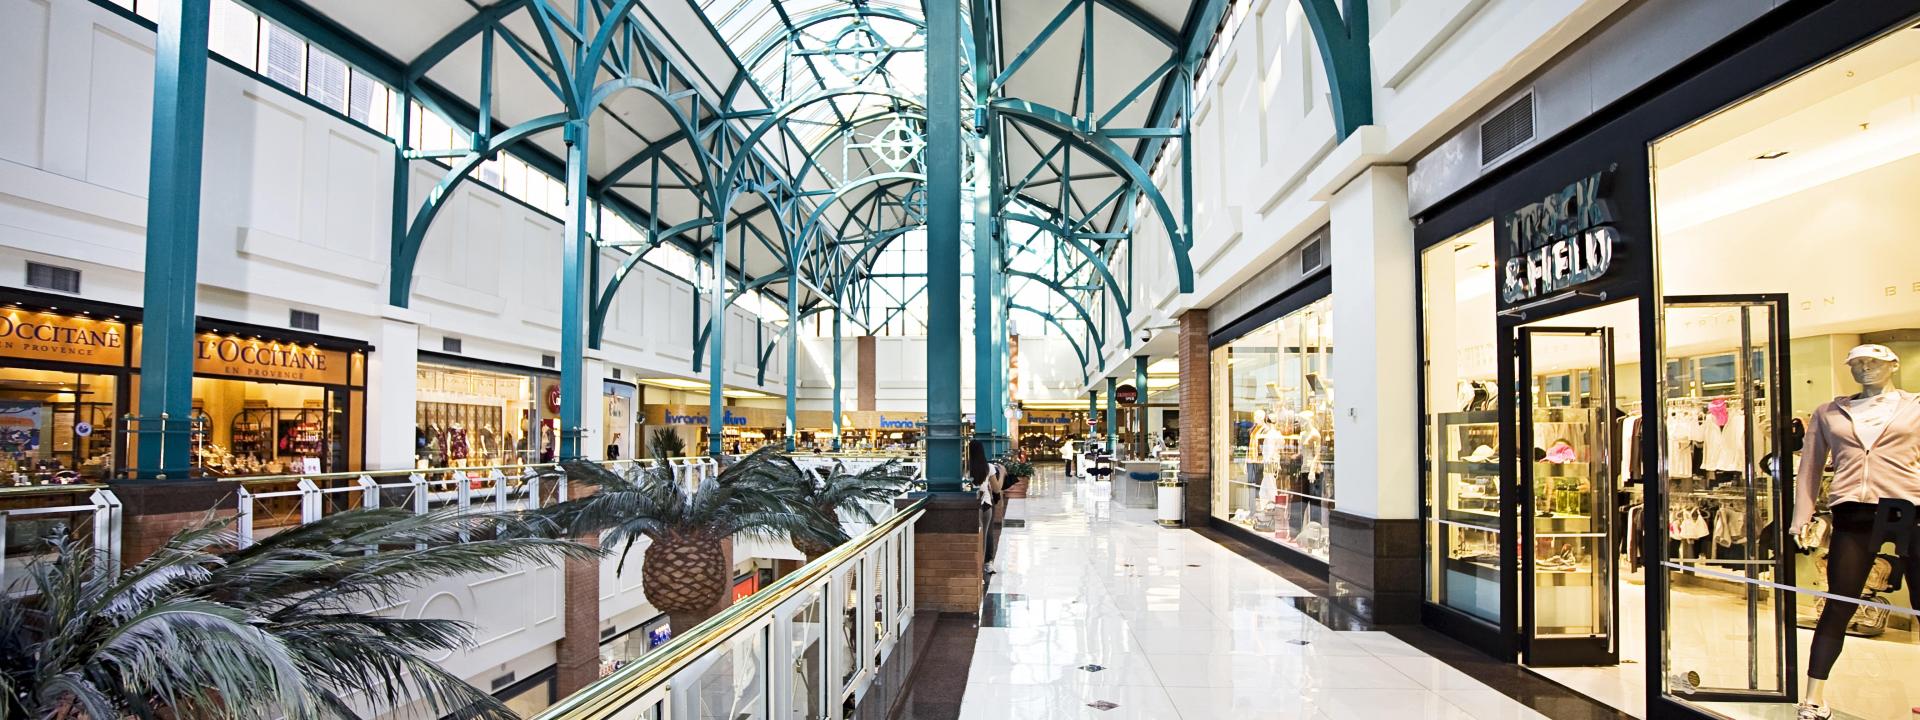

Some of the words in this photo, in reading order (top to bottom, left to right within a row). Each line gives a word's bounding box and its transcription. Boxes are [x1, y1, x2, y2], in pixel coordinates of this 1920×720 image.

[23, 343, 94, 356] PROVENCE
[197, 338, 327, 372] L'OCCITANE
[225, 366, 239, 375] EN
[247, 367, 305, 381] PROVENCE
